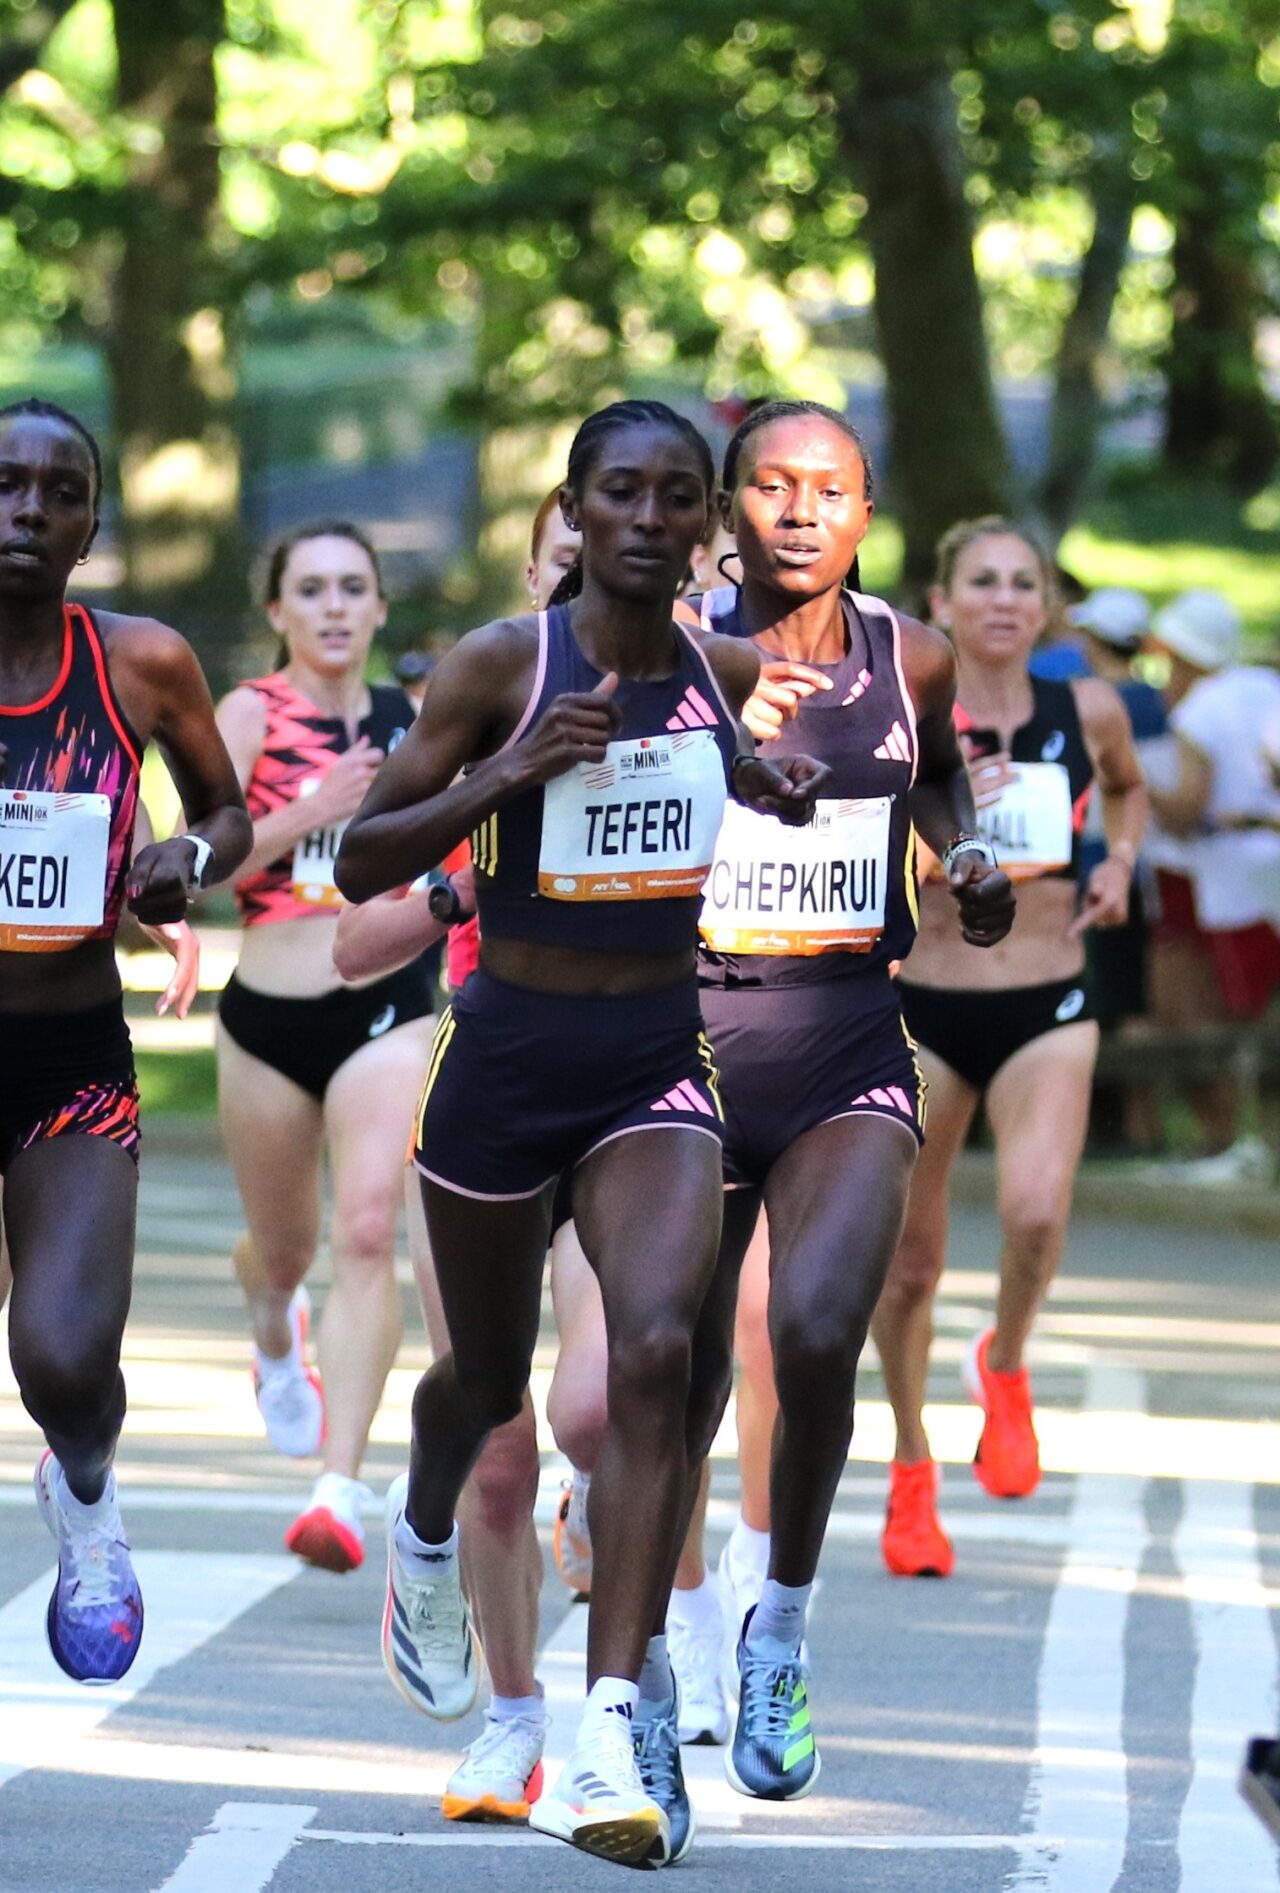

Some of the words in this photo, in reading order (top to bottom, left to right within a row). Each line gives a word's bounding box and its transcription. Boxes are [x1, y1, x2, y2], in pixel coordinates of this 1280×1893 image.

[634, 750, 659, 771] MINI
[4, 802, 33, 822] MINI
[34, 808, 48, 819] 10K
[585, 797, 692, 857] TEFERI
[713, 858, 876, 913] CHEPKIRUI
